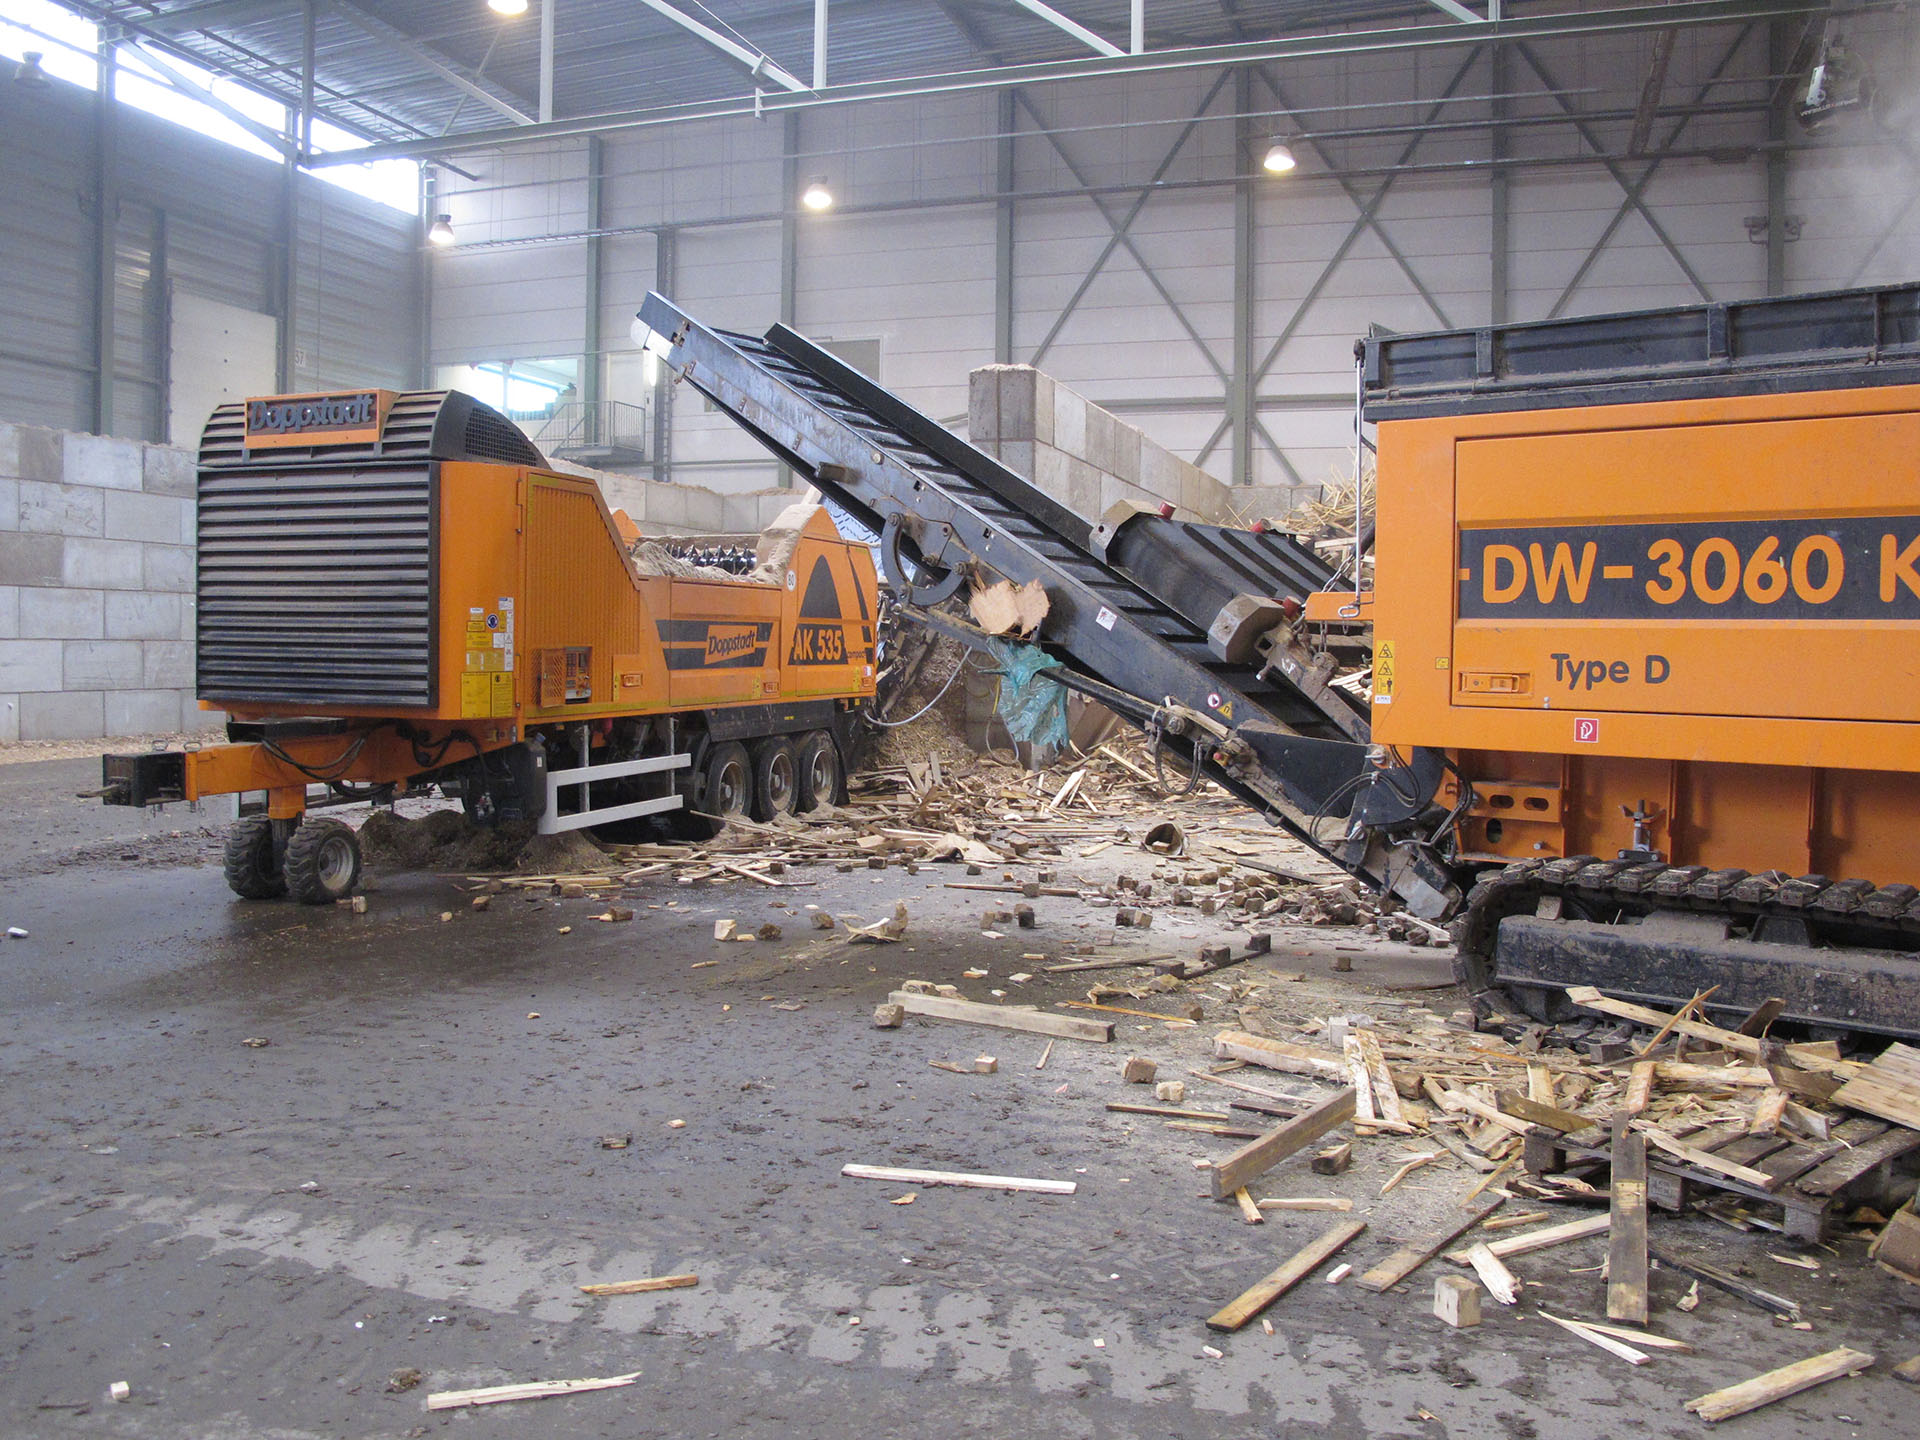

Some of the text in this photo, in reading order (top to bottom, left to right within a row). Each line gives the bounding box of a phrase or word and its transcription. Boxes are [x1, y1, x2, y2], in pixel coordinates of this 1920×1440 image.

[249, 394, 373, 433] Doppstadt
[1879, 533, 1920, 603] K
[708, 630, 755, 656] Doppstadt
[793, 628, 842, 661] AK 535
[1550, 652, 1670, 690] Type D
